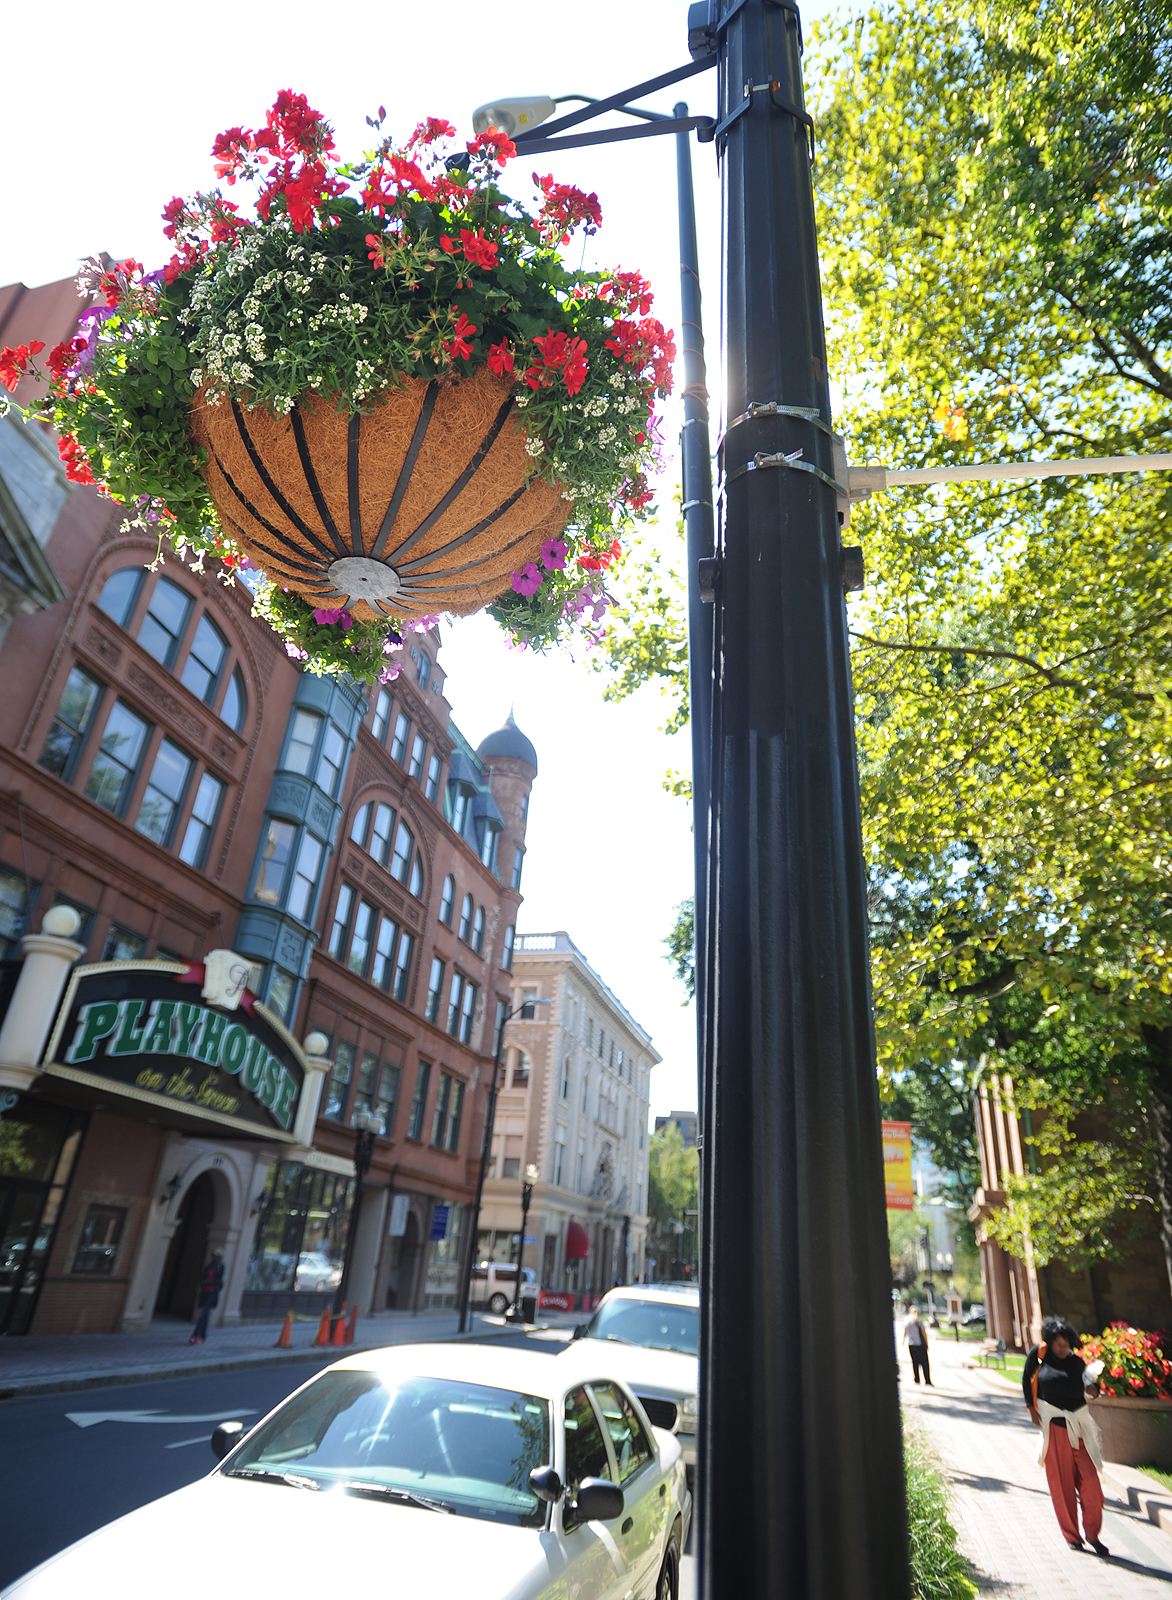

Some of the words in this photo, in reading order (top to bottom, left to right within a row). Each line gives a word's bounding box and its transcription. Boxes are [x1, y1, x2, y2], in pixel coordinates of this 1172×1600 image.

[65, 1000, 298, 1130] PLAYHOUSE
[136, 1068, 164, 1091] on
[165, 1066, 196, 1100] the
